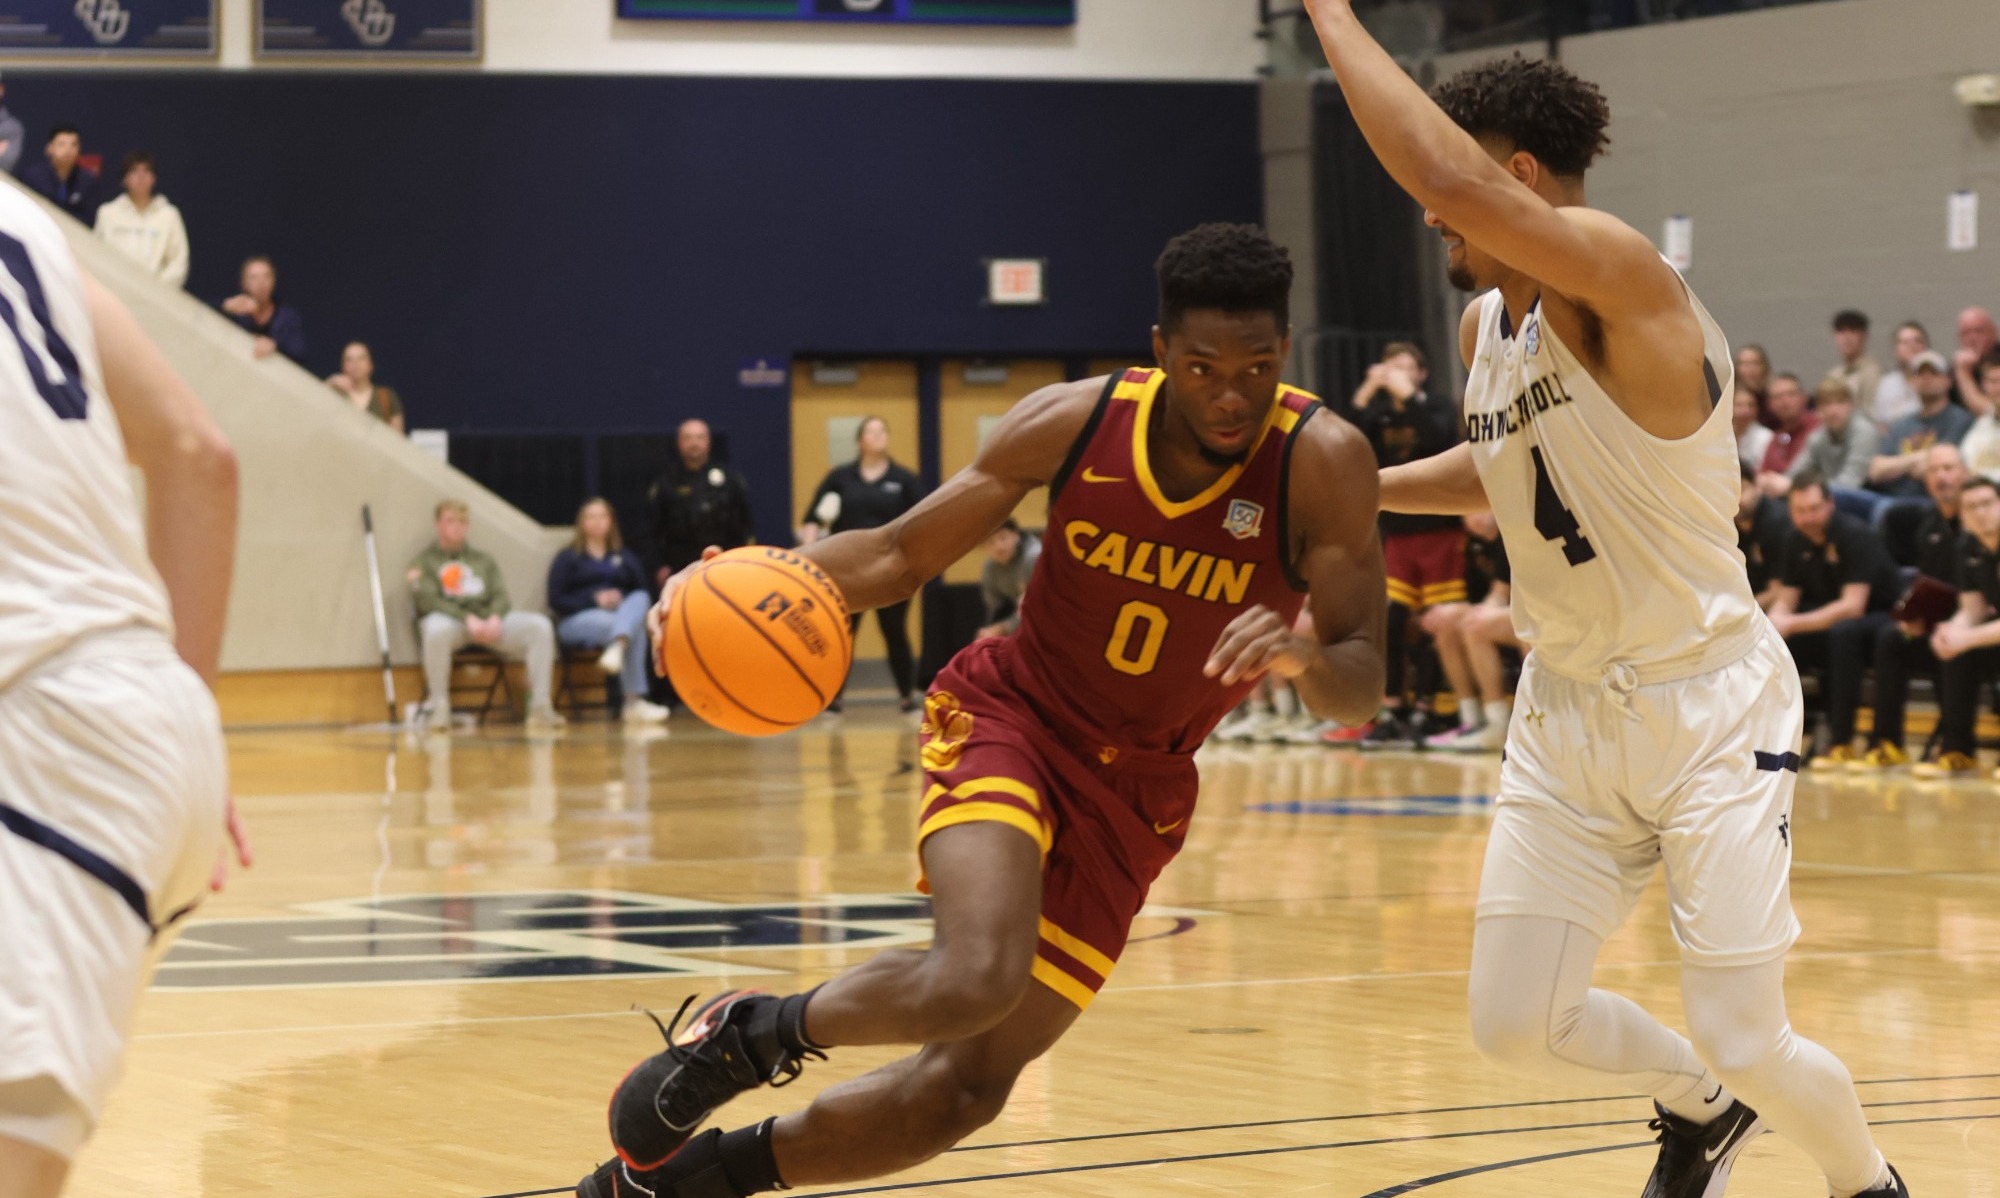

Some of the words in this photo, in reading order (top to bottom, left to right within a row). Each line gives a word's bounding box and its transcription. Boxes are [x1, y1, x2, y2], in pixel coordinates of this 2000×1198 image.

[1468, 408, 1508, 444] OHN
[1506, 372, 1573, 434] COLL
[1530, 444, 1597, 567] 4
[1064, 519, 1257, 604] CALVIN
[1104, 600, 1170, 676] 0
